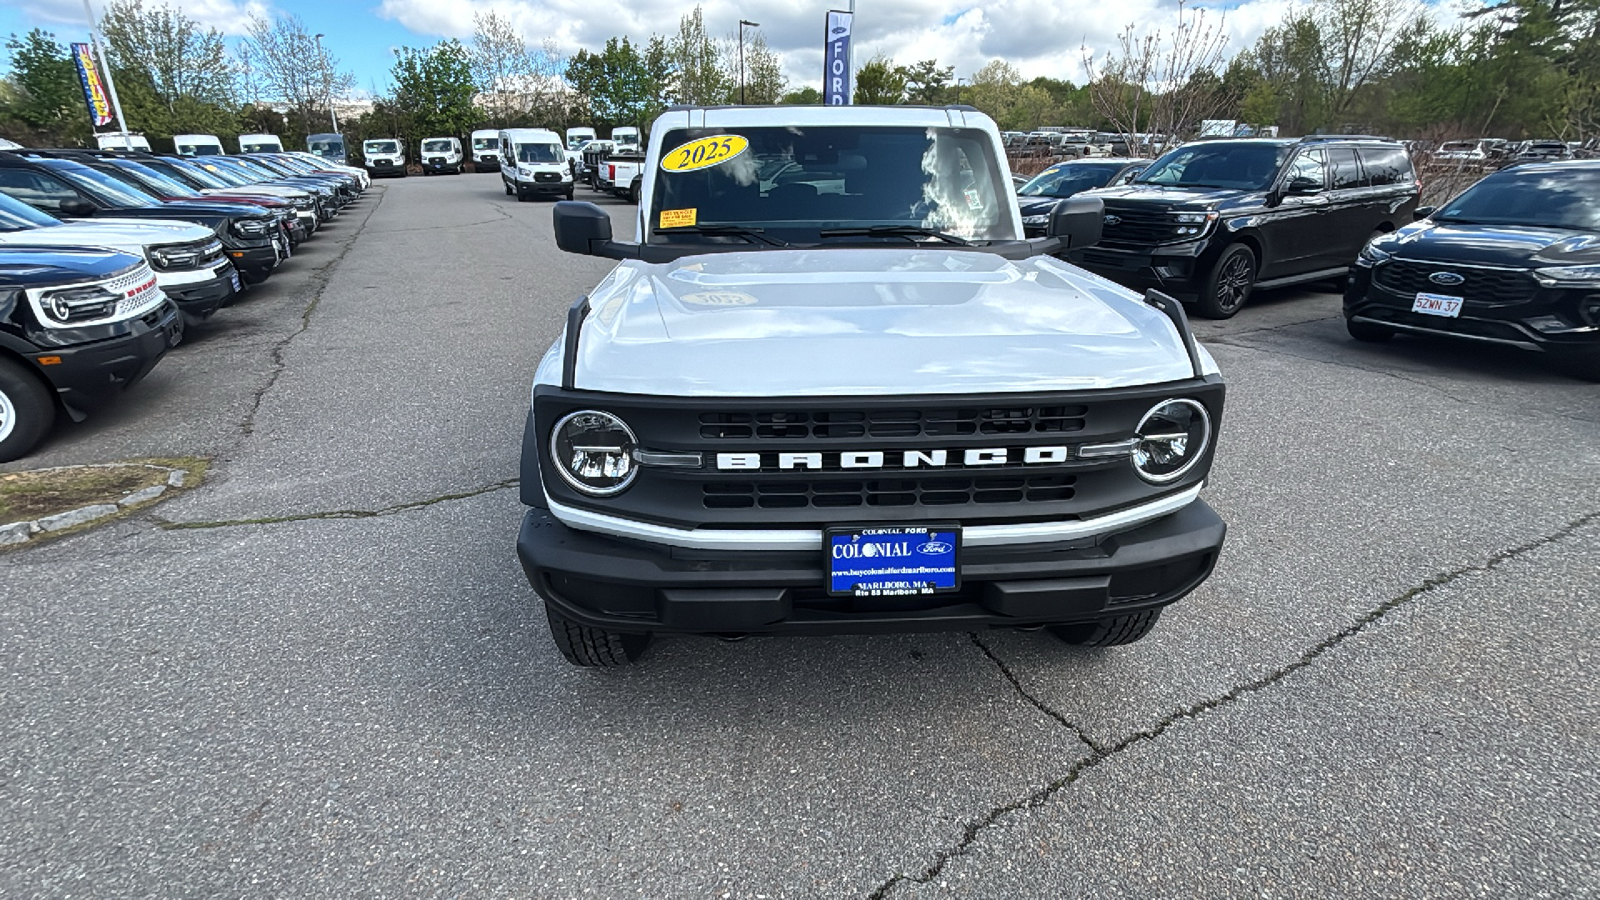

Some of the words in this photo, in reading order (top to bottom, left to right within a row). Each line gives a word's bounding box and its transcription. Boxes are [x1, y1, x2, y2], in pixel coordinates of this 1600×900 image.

[832, 41, 844, 106] FORD
[80, 53, 108, 116] SALE
[677, 138, 733, 168] 2025
[1415, 298, 1442, 311] 5ZWN
[1444, 301, 1459, 312] 37
[716, 446, 1068, 470] BRONCO
[861, 528, 902, 536] COLONIAL
[832, 541, 912, 559] COLONIAL
[831, 566, 956, 577] www.buycolonialfordmarlboro.com
[855, 589, 869, 597] Rte
[883, 588, 918, 596] Marlboro
[921, 587, 934, 595] MA
